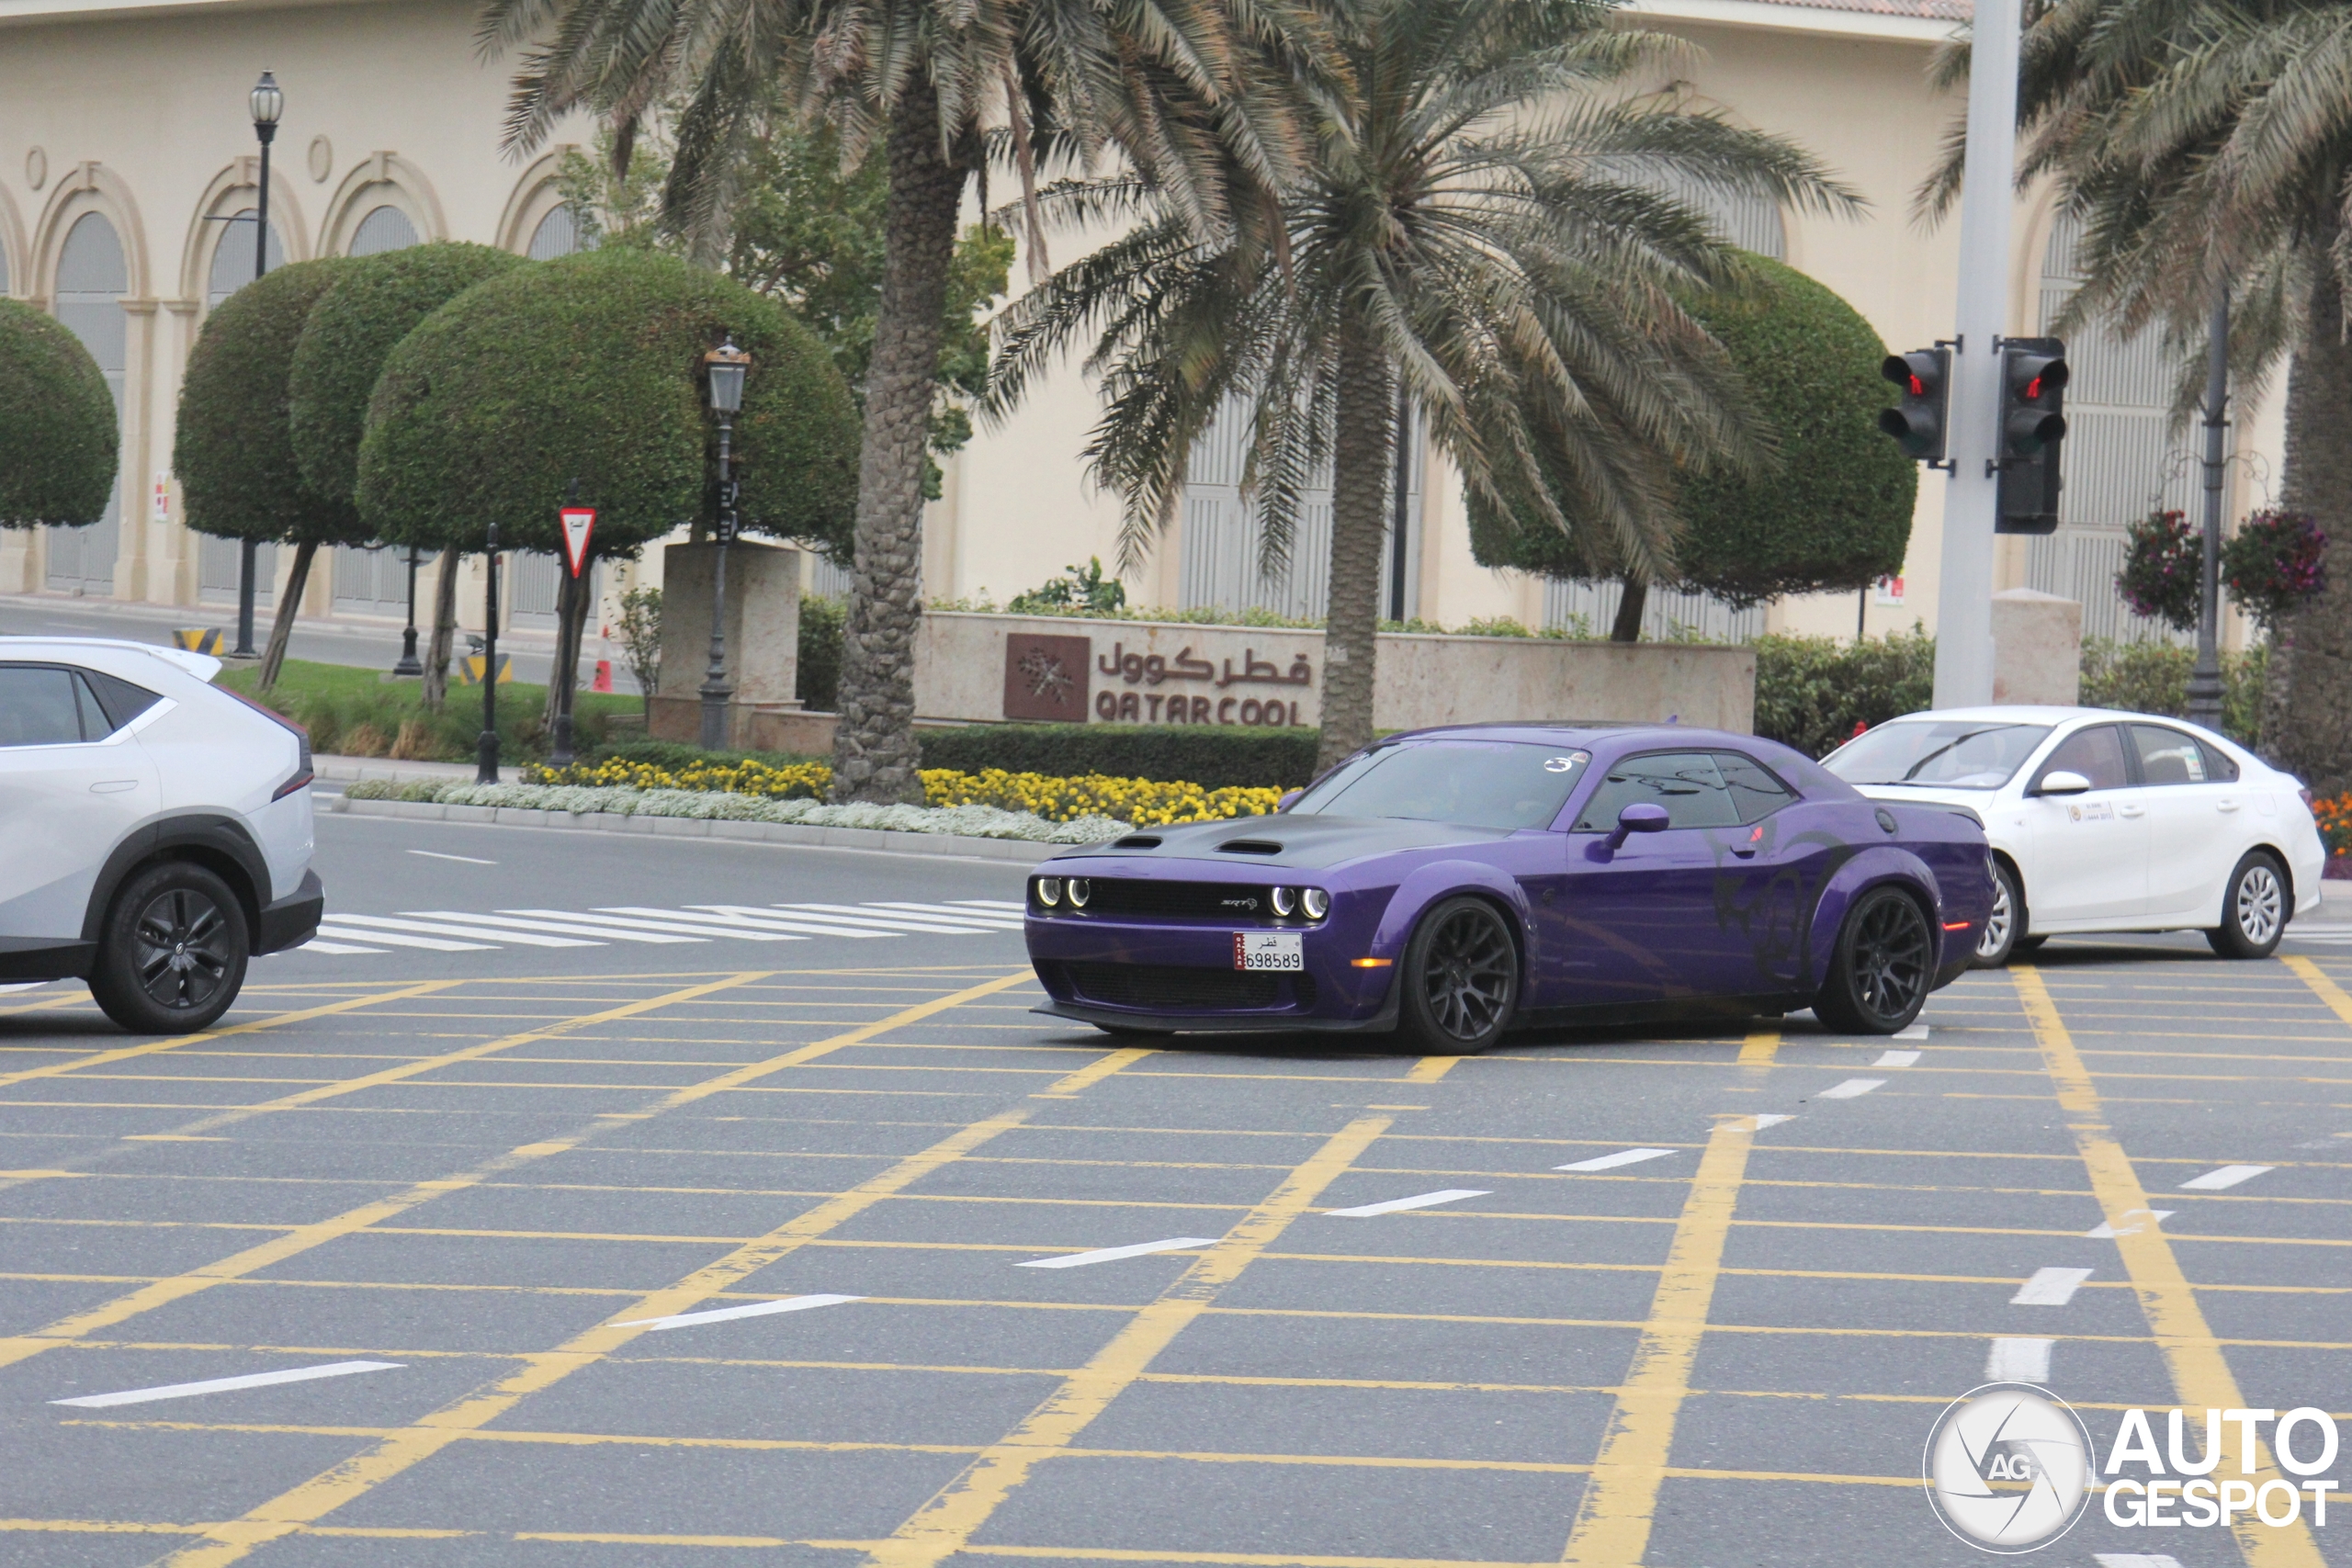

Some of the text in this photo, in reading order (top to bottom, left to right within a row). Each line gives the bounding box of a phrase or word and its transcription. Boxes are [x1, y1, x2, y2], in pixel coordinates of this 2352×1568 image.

[1221, 899, 1248, 908] SRT
[1258, 937, 1277, 950] قطر
[1246, 953, 1300, 968] 698589
